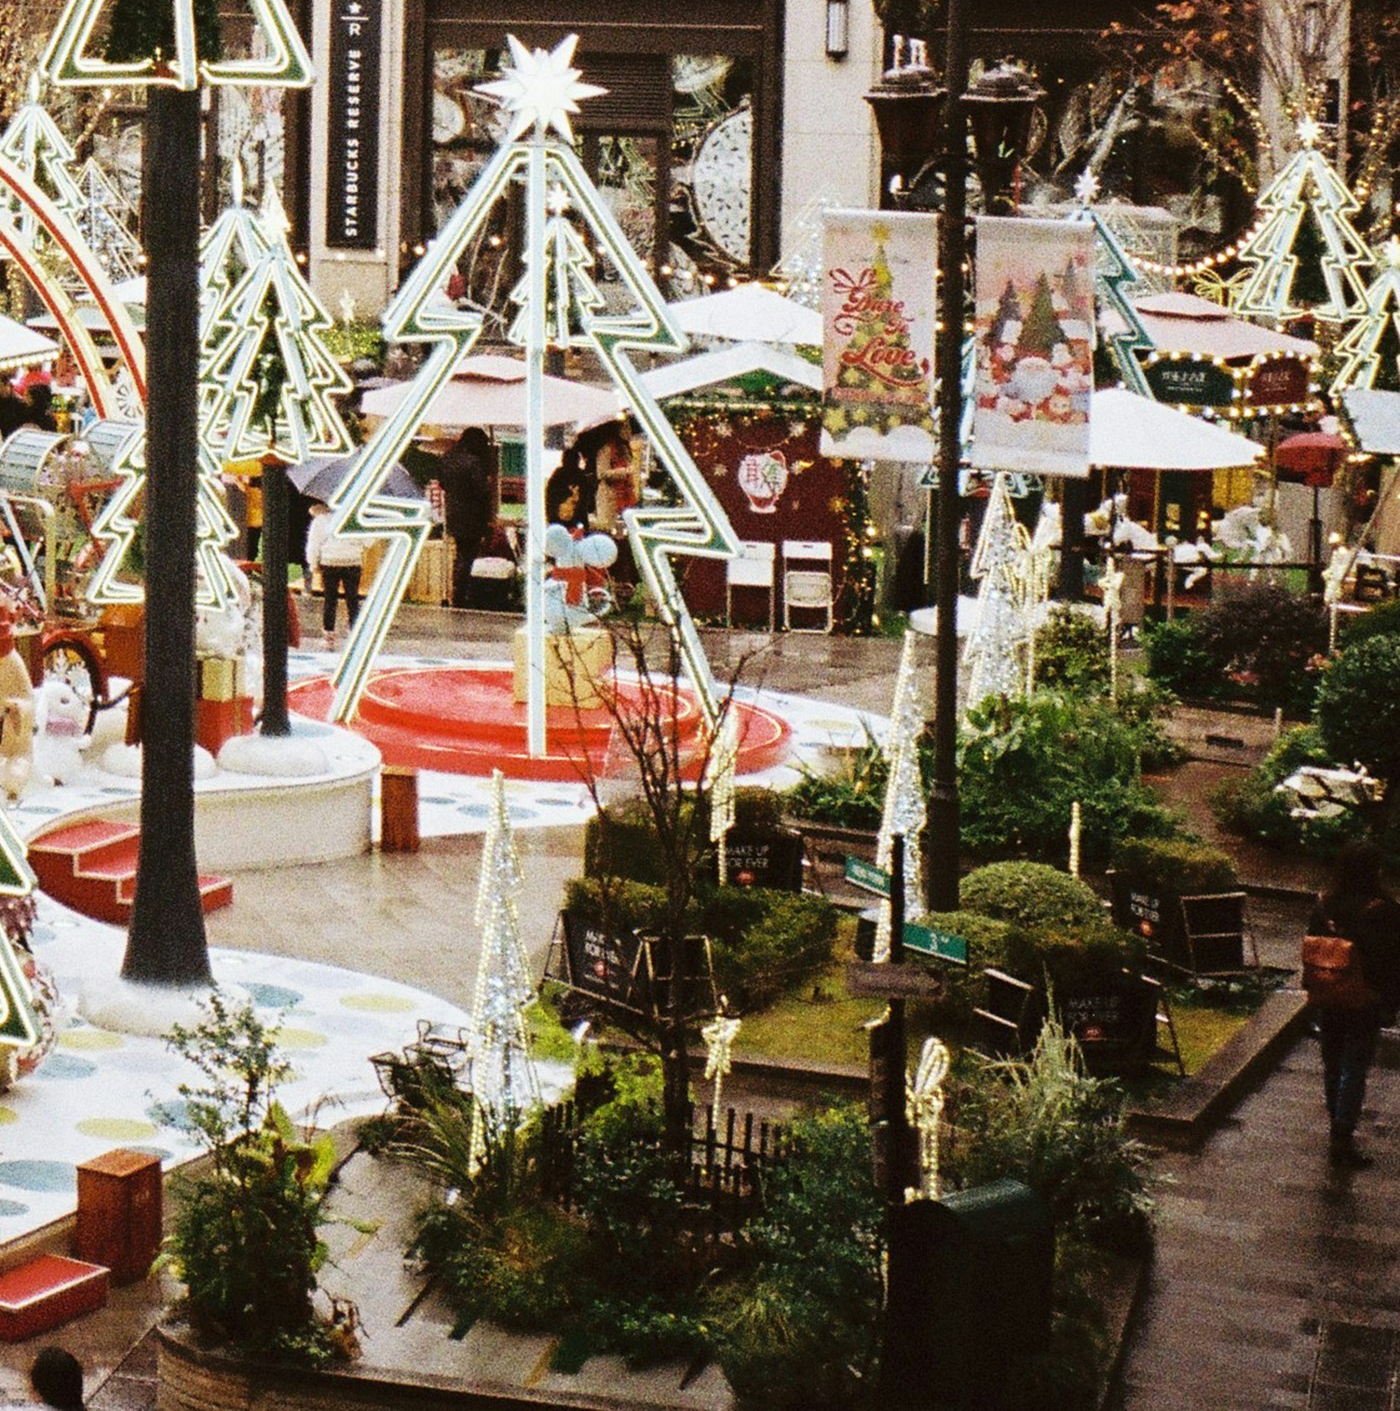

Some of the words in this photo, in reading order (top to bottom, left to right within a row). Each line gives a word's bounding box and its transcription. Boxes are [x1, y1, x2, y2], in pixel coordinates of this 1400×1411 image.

[349, 24, 361, 37] R
[347, 50, 362, 129] RESERVE
[345, 138, 360, 237] STARBUCKS
[842, 338, 917, 367] Love
